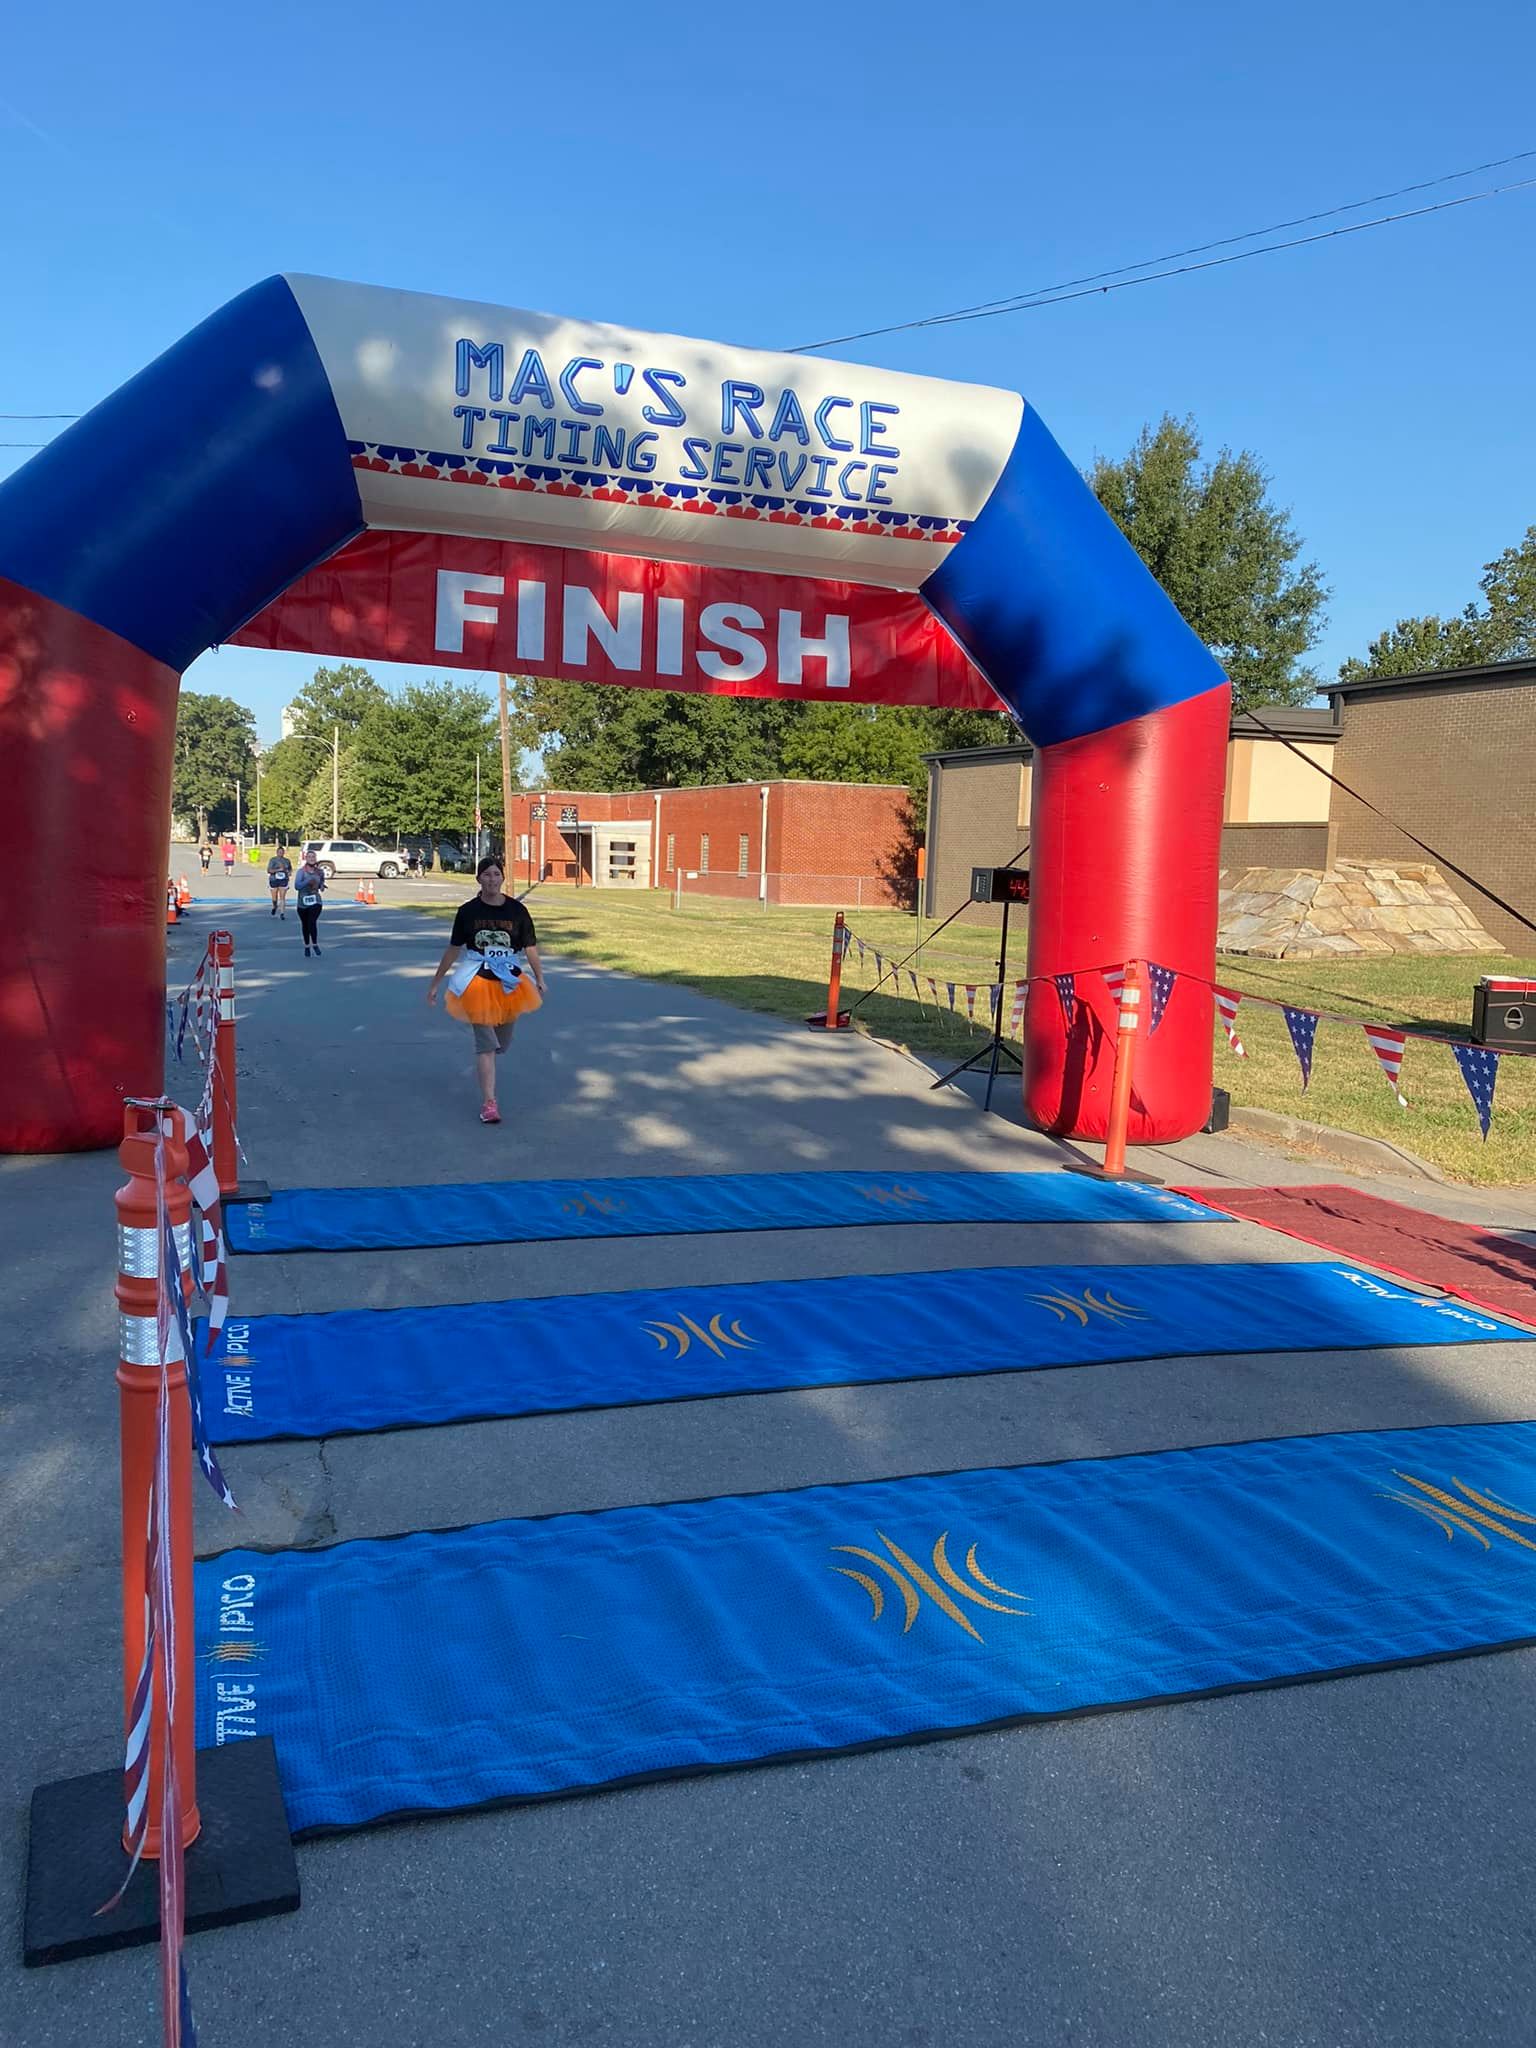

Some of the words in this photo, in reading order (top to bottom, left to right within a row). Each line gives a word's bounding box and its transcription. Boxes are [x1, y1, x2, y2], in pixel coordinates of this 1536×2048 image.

[455, 338, 687, 428] MAC'S
[721, 379, 901, 458] RACE
[453, 404, 660, 473] TIMING
[679, 437, 899, 505] SERVICE
[434, 568, 852, 688] FINISH
[226, 1324, 250, 1354] IPICO
[1436, 1308, 1498, 1332] IPICO
[223, 1374, 255, 1418] ACTIVE
[219, 1574, 256, 1632] IPICO
[216, 1682, 257, 1747] TIVE
